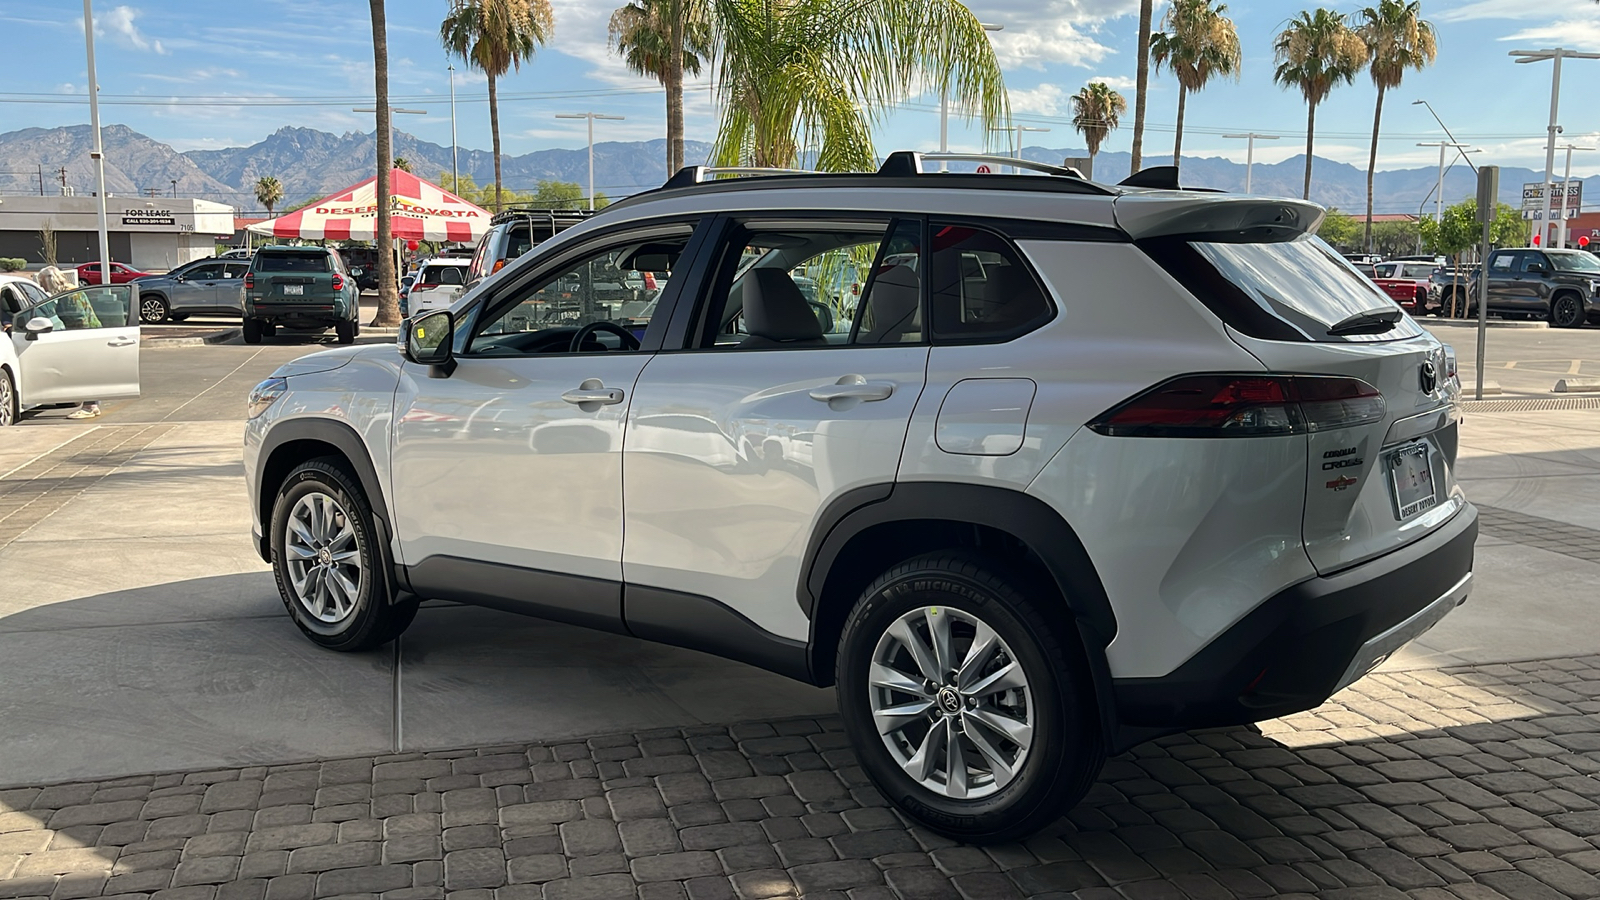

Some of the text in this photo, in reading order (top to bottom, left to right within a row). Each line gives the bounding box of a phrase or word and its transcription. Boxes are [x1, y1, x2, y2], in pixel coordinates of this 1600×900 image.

[125, 209, 143, 217] FOR
[316, 203, 479, 217] DESER TOYOTA
[1323, 447, 1357, 459] COROLLA
[1322, 458, 1364, 471] CROSS
[1401, 502, 1418, 517] DESERT
[349, 510, 369, 566] MICHELIN
[914, 580, 985, 605] MICHELIN
